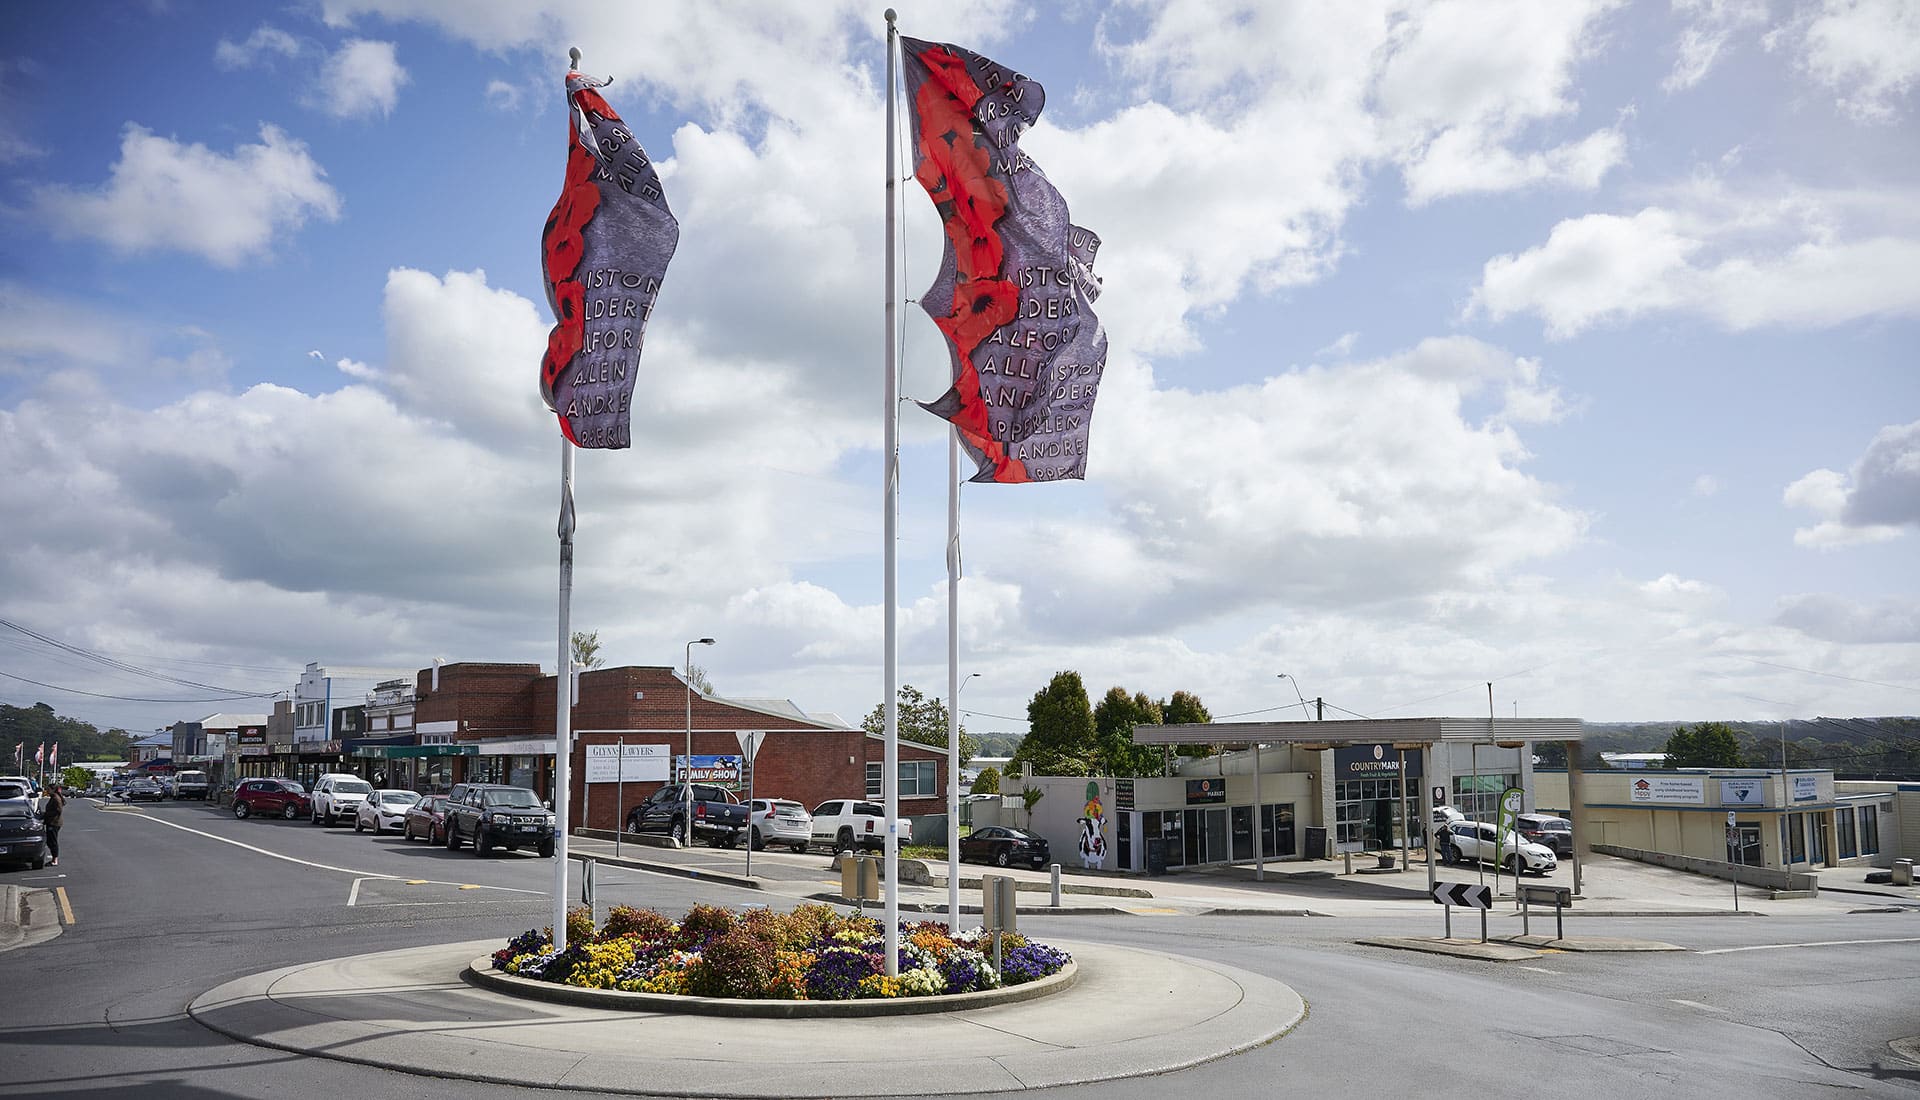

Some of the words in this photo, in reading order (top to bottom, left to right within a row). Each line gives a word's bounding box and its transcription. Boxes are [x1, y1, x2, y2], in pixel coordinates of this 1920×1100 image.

[1019, 439, 1083, 460] ANDRE
[622, 745, 654, 756] LAWYERS
[1350, 761, 1407, 771] COUNTRYMARKT
[713, 769, 738, 780] SHOW
